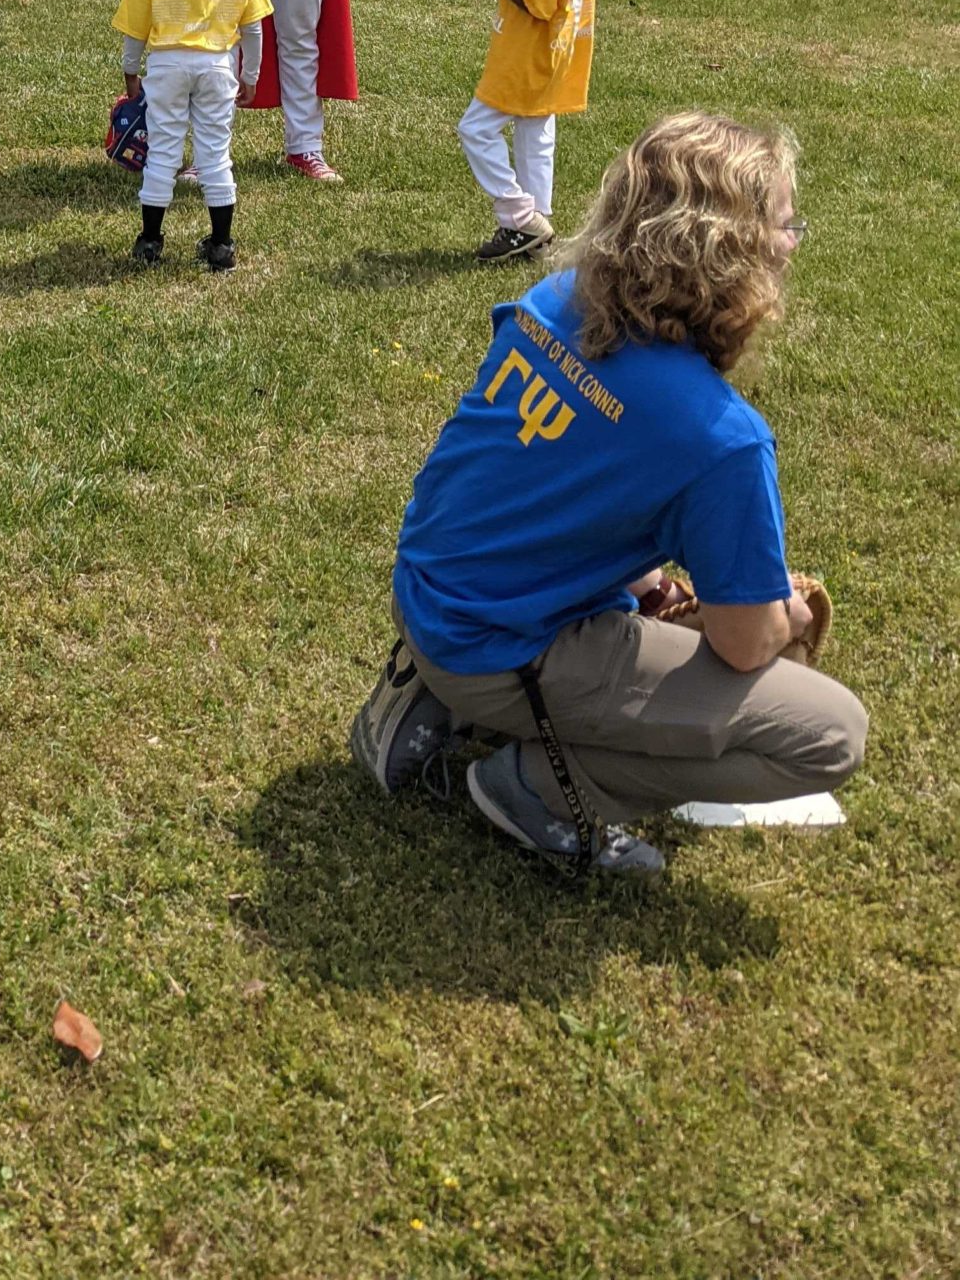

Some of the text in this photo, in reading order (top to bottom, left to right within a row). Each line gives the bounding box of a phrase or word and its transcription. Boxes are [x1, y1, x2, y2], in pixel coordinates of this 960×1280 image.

[548, 341, 565, 363] OF
[559, 352, 586, 384] NICK
[578, 374, 625, 424] CONNER
